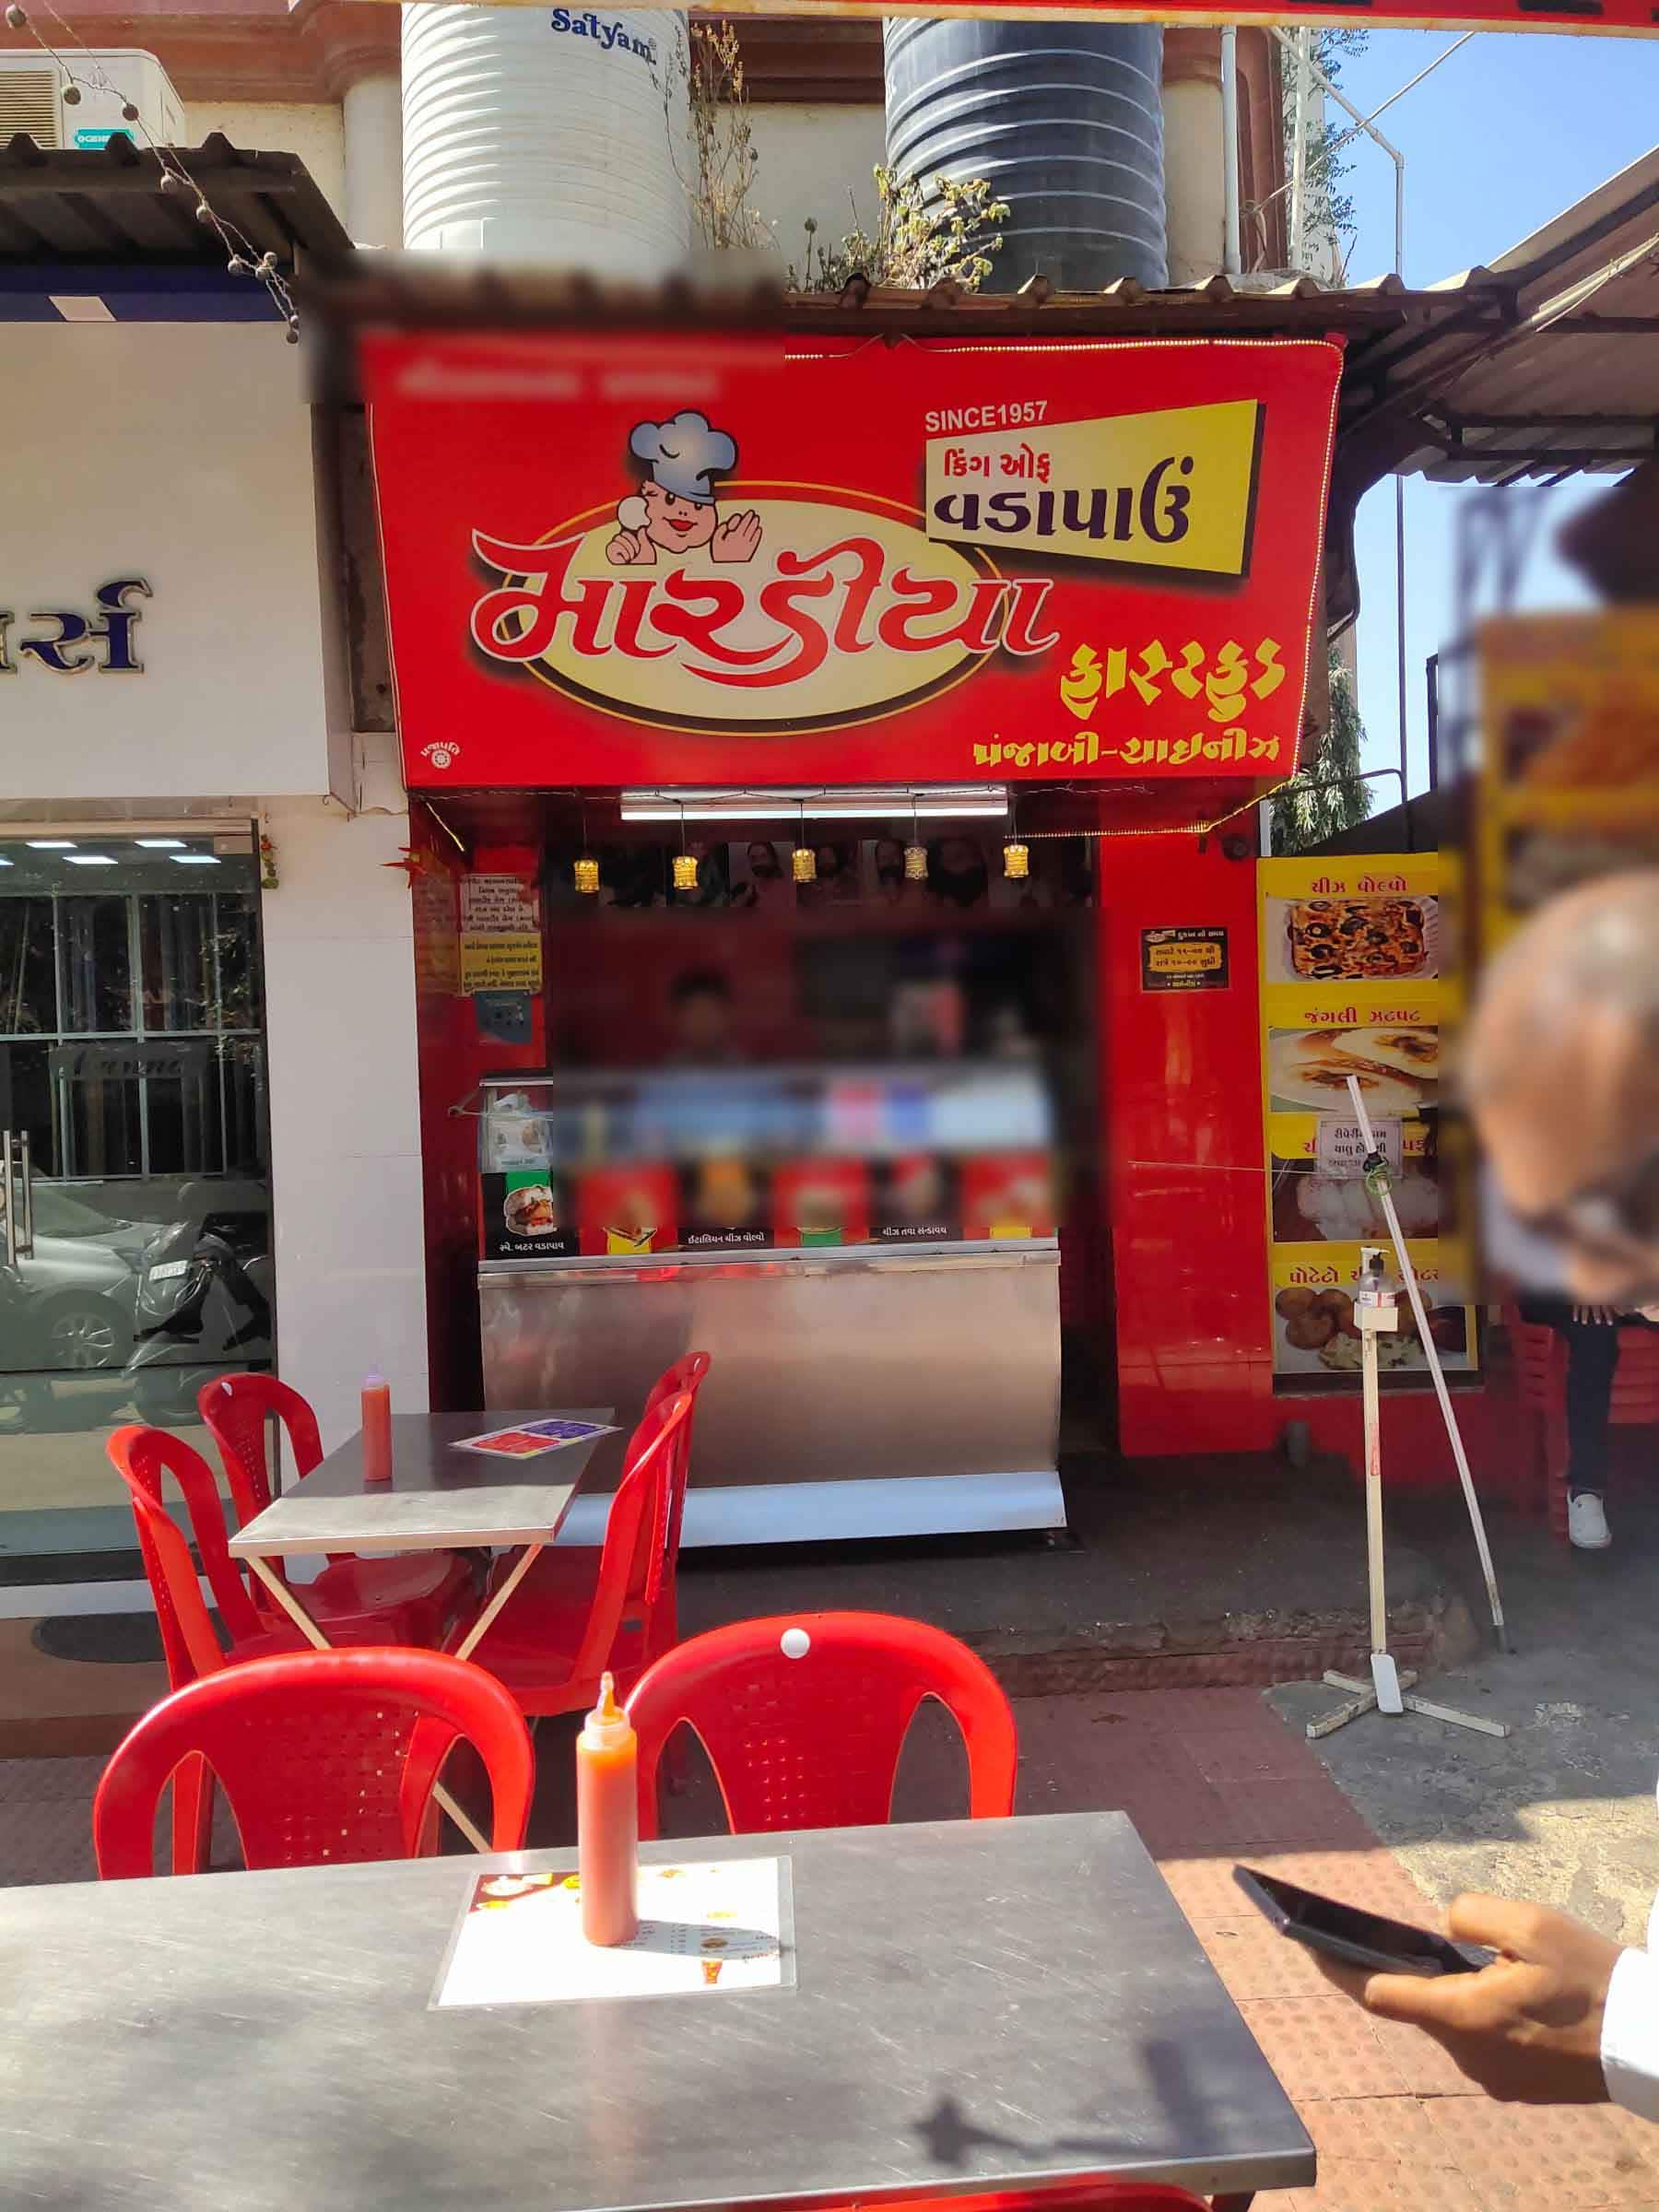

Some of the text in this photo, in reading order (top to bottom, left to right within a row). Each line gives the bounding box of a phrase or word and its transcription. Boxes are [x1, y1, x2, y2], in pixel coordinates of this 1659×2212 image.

[551, 7, 656, 65] Satyam
[924, 400, 1048, 432] SINCE1957
[944, 443, 1051, 484] કિંગ ઓફ
